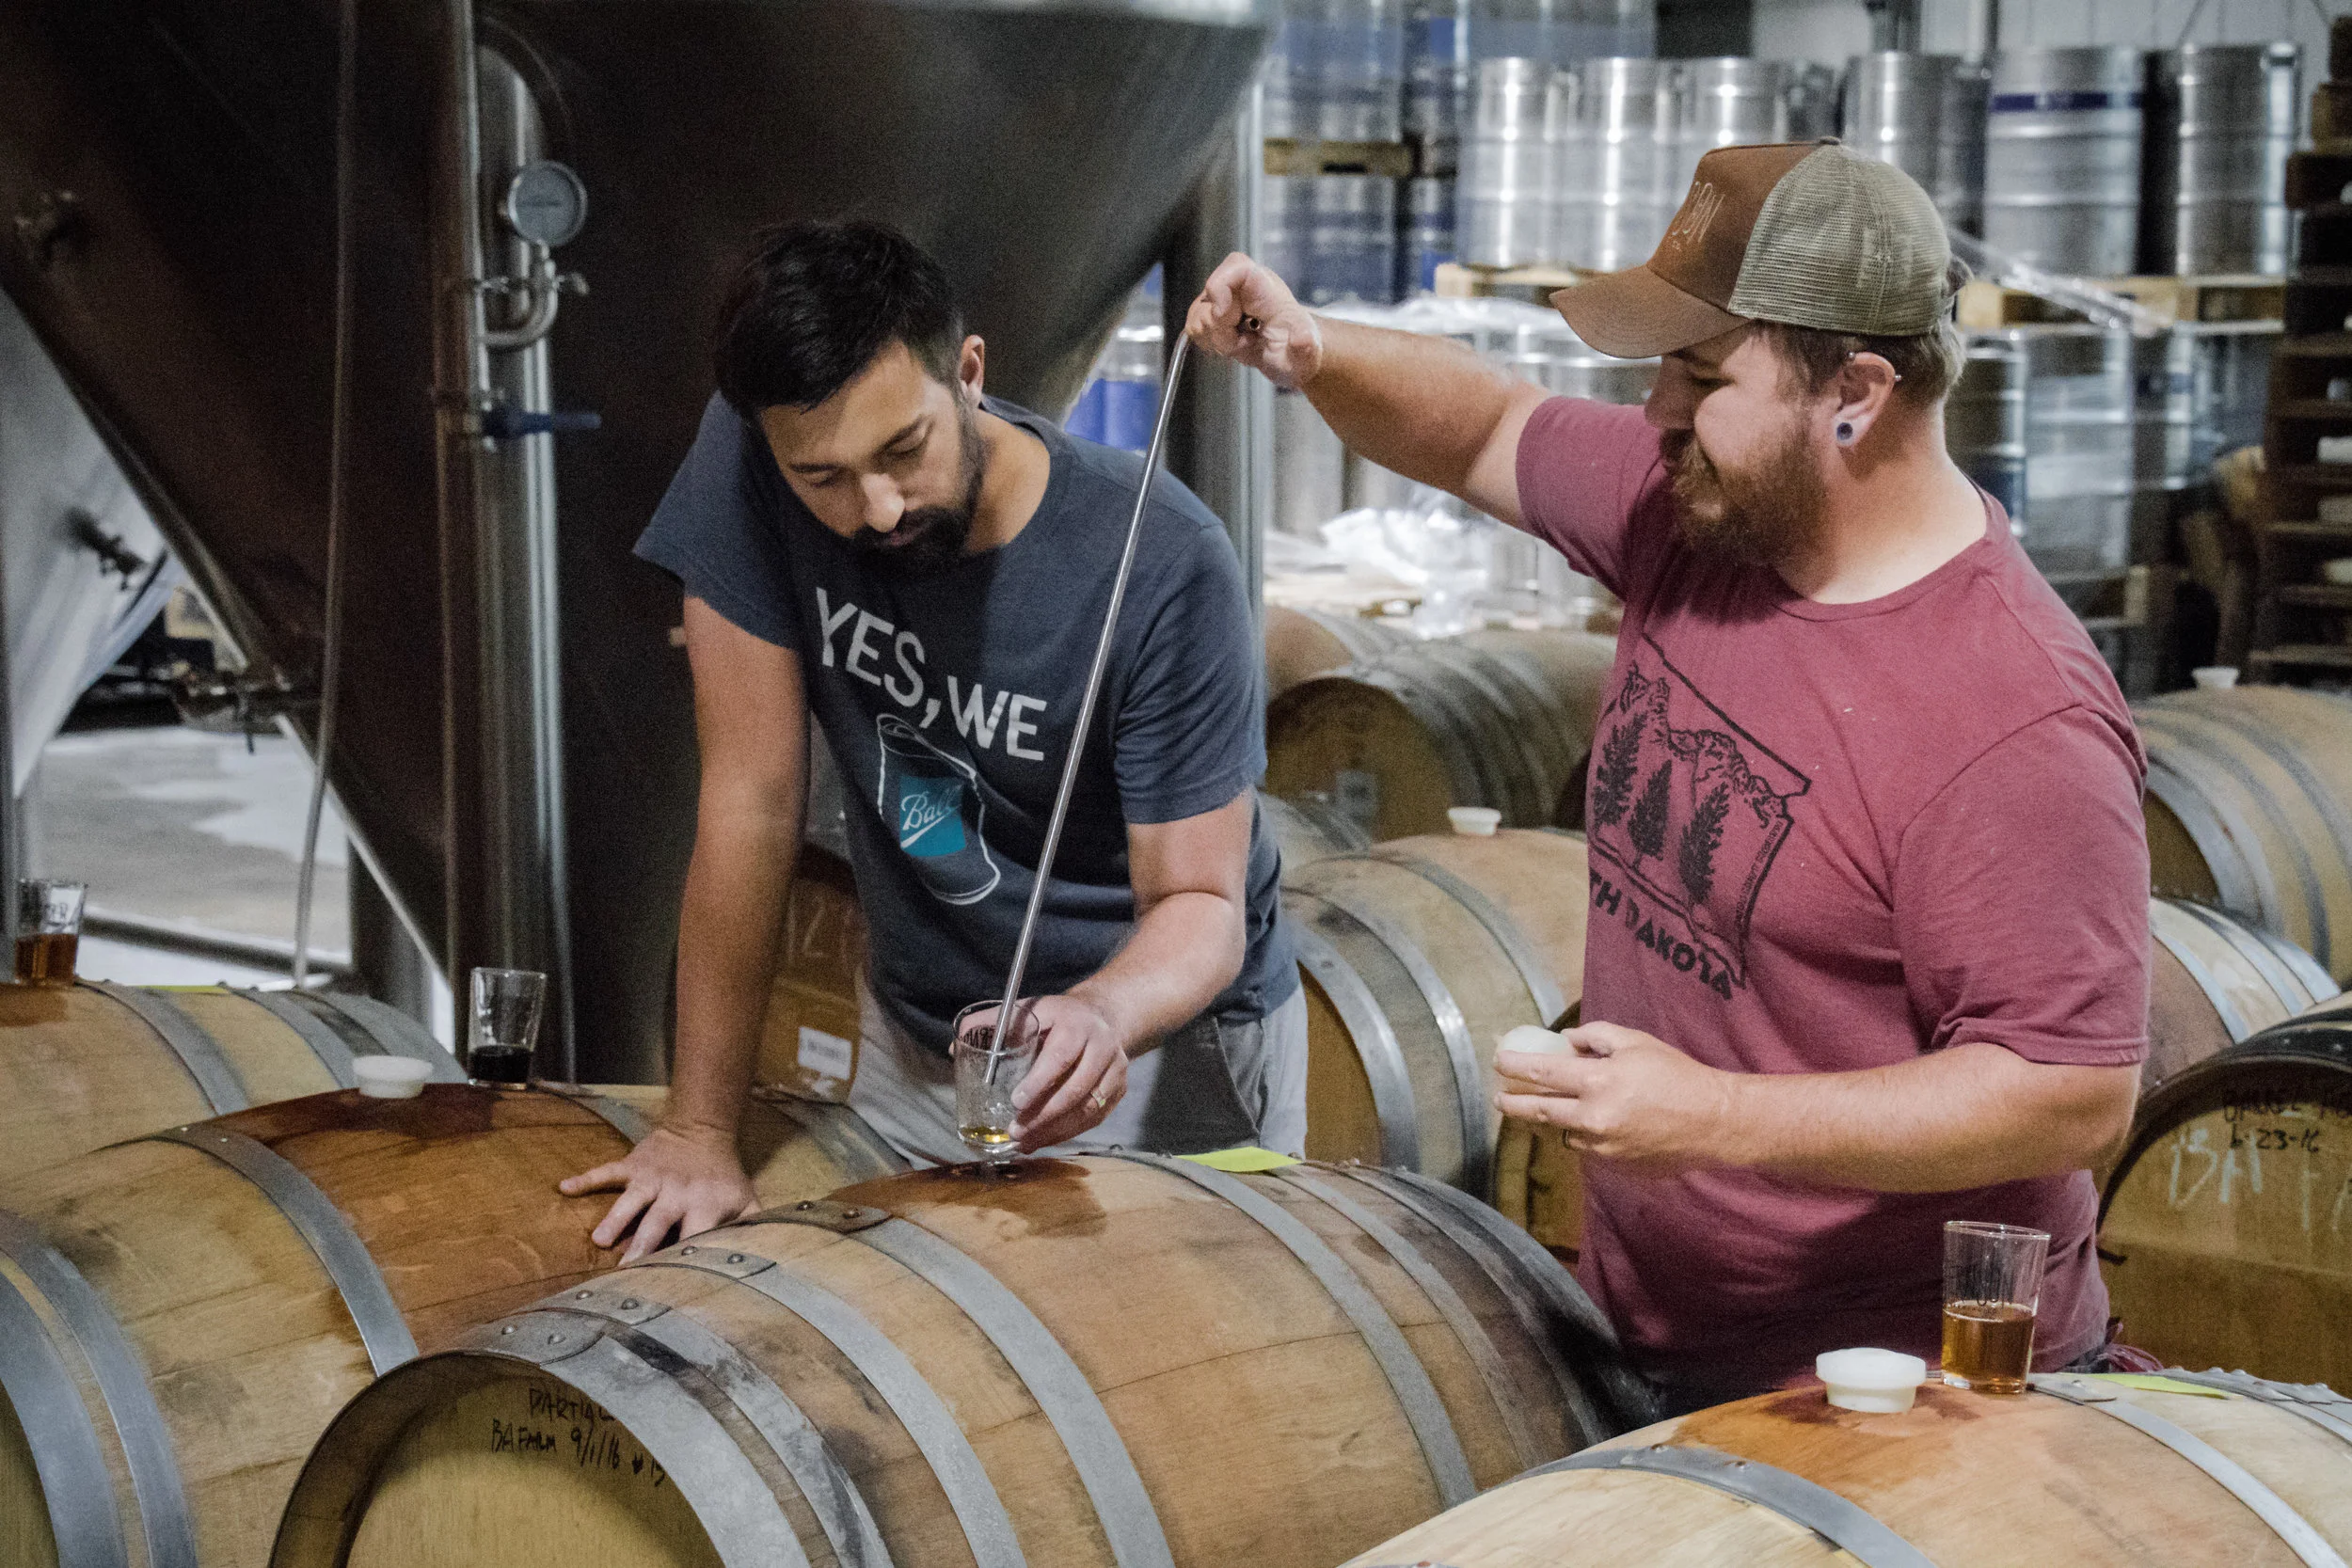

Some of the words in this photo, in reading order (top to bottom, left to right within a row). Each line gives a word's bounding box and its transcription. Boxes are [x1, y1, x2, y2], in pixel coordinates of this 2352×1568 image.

[816, 586, 941, 729] YES,
[947, 674, 1047, 762] WE
[1625, 896, 1733, 1001] DAKOTA
